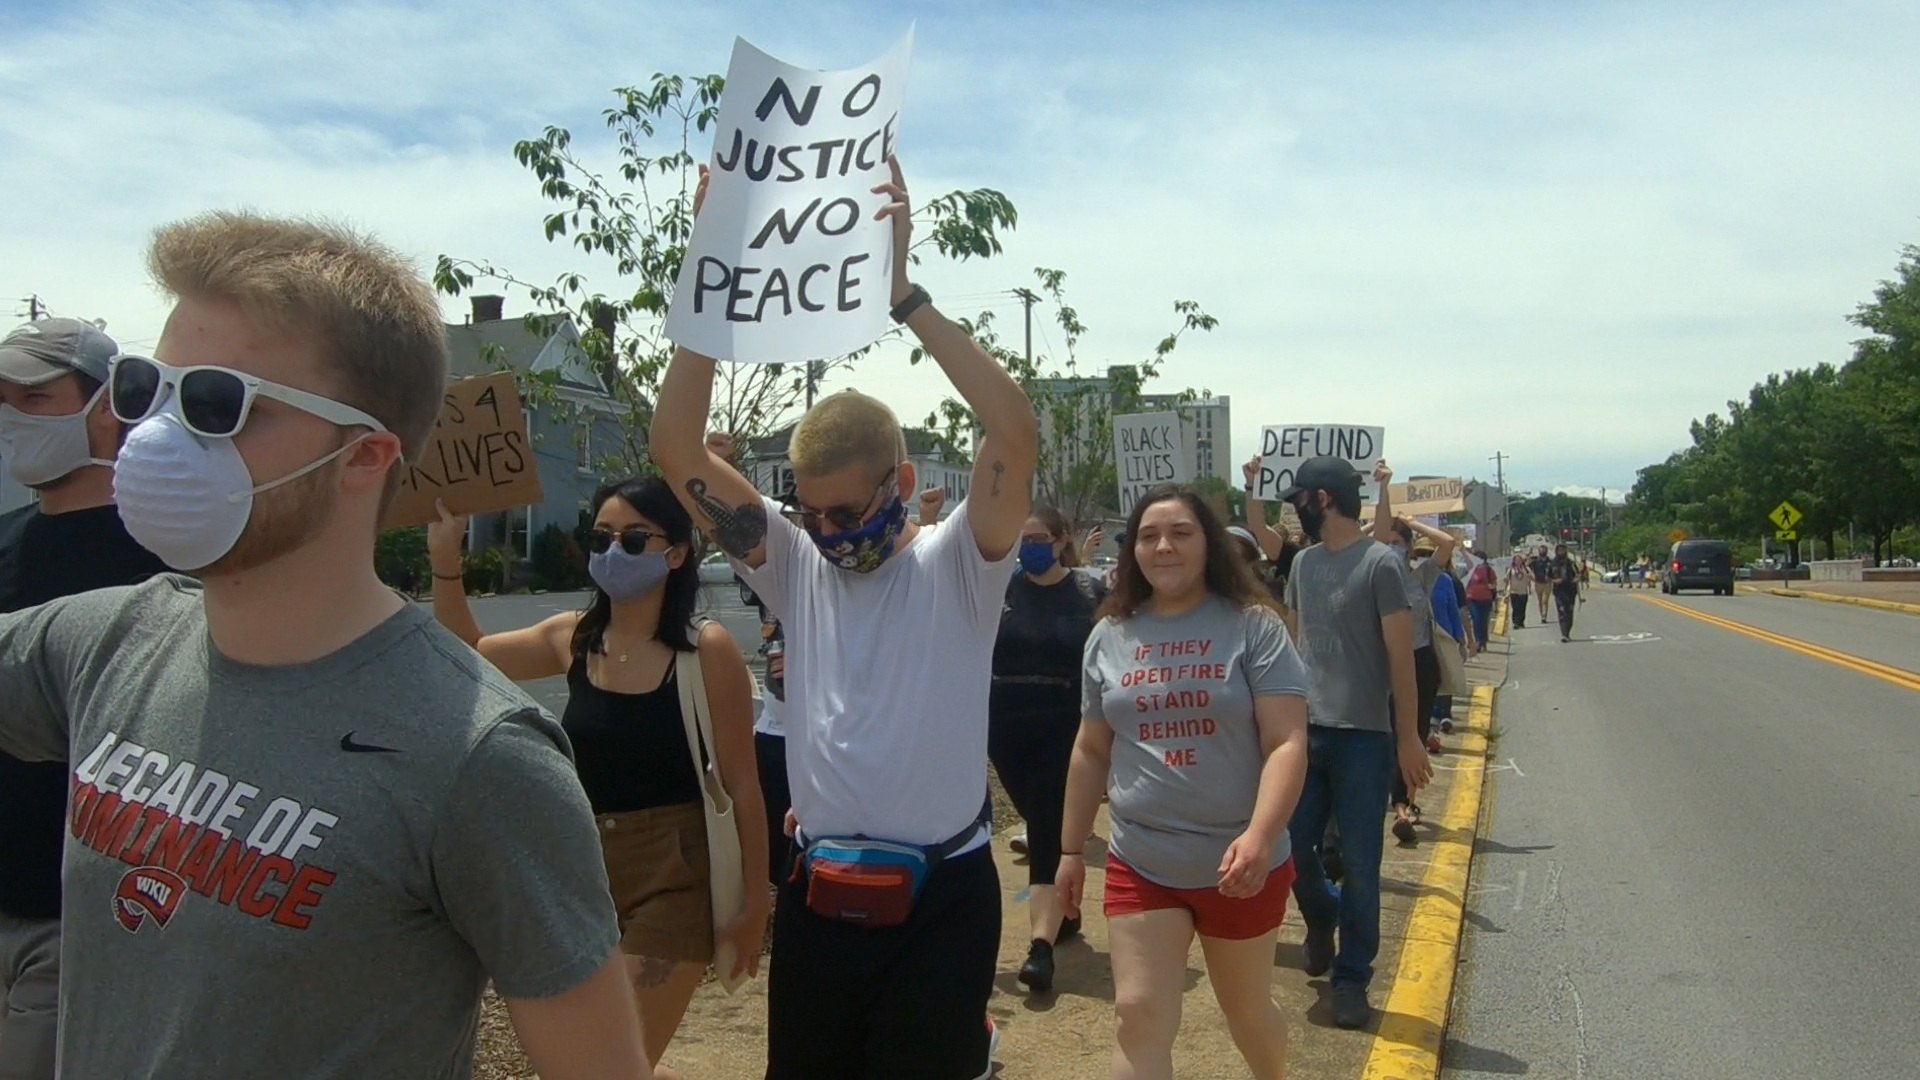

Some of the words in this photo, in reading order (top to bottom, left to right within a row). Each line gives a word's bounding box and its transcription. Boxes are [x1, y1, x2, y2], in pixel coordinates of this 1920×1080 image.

[754, 73, 882, 127] NO
[716, 110, 898, 182] JUSTICE
[747, 197, 860, 249] NO
[694, 253, 870, 322] PEACE
[437, 430, 525, 487] LIVES
[1121, 425, 1175, 452] BLACK
[1262, 427, 1374, 460] DEFUND
[1125, 454, 1175, 482] LIVES
[1134, 643, 1153, 661] IF
[1158, 639, 1211, 657] THEY
[1178, 663, 1225, 680] FIRE
[1164, 748, 1197, 767] ME
[245, 796, 340, 860] OF
[71, 775, 338, 931] OMINANCE
[136, 875, 172, 907] WKU
